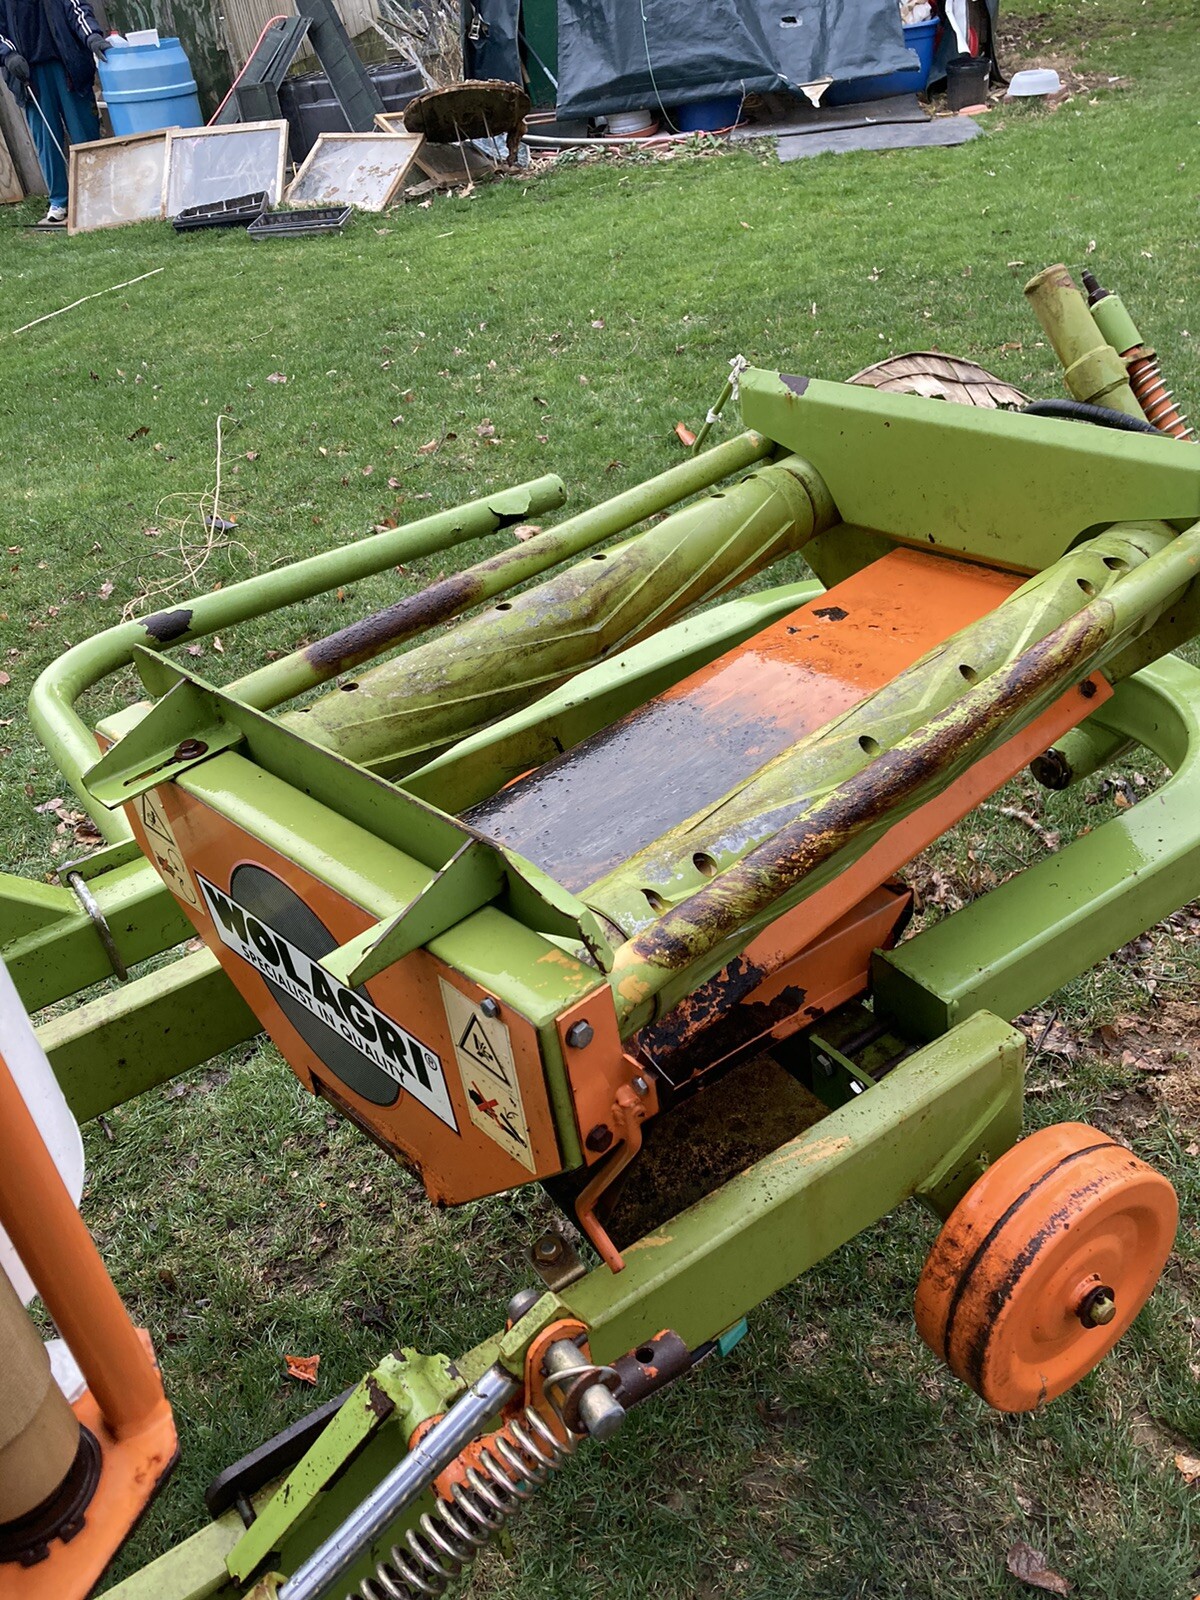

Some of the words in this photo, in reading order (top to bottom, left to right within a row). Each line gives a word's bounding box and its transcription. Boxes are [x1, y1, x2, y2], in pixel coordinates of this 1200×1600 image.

[240, 944, 313, 1010] SPECIALIST
[317, 1004, 337, 1029] IN
[340, 1023, 405, 1084] QUALITY
